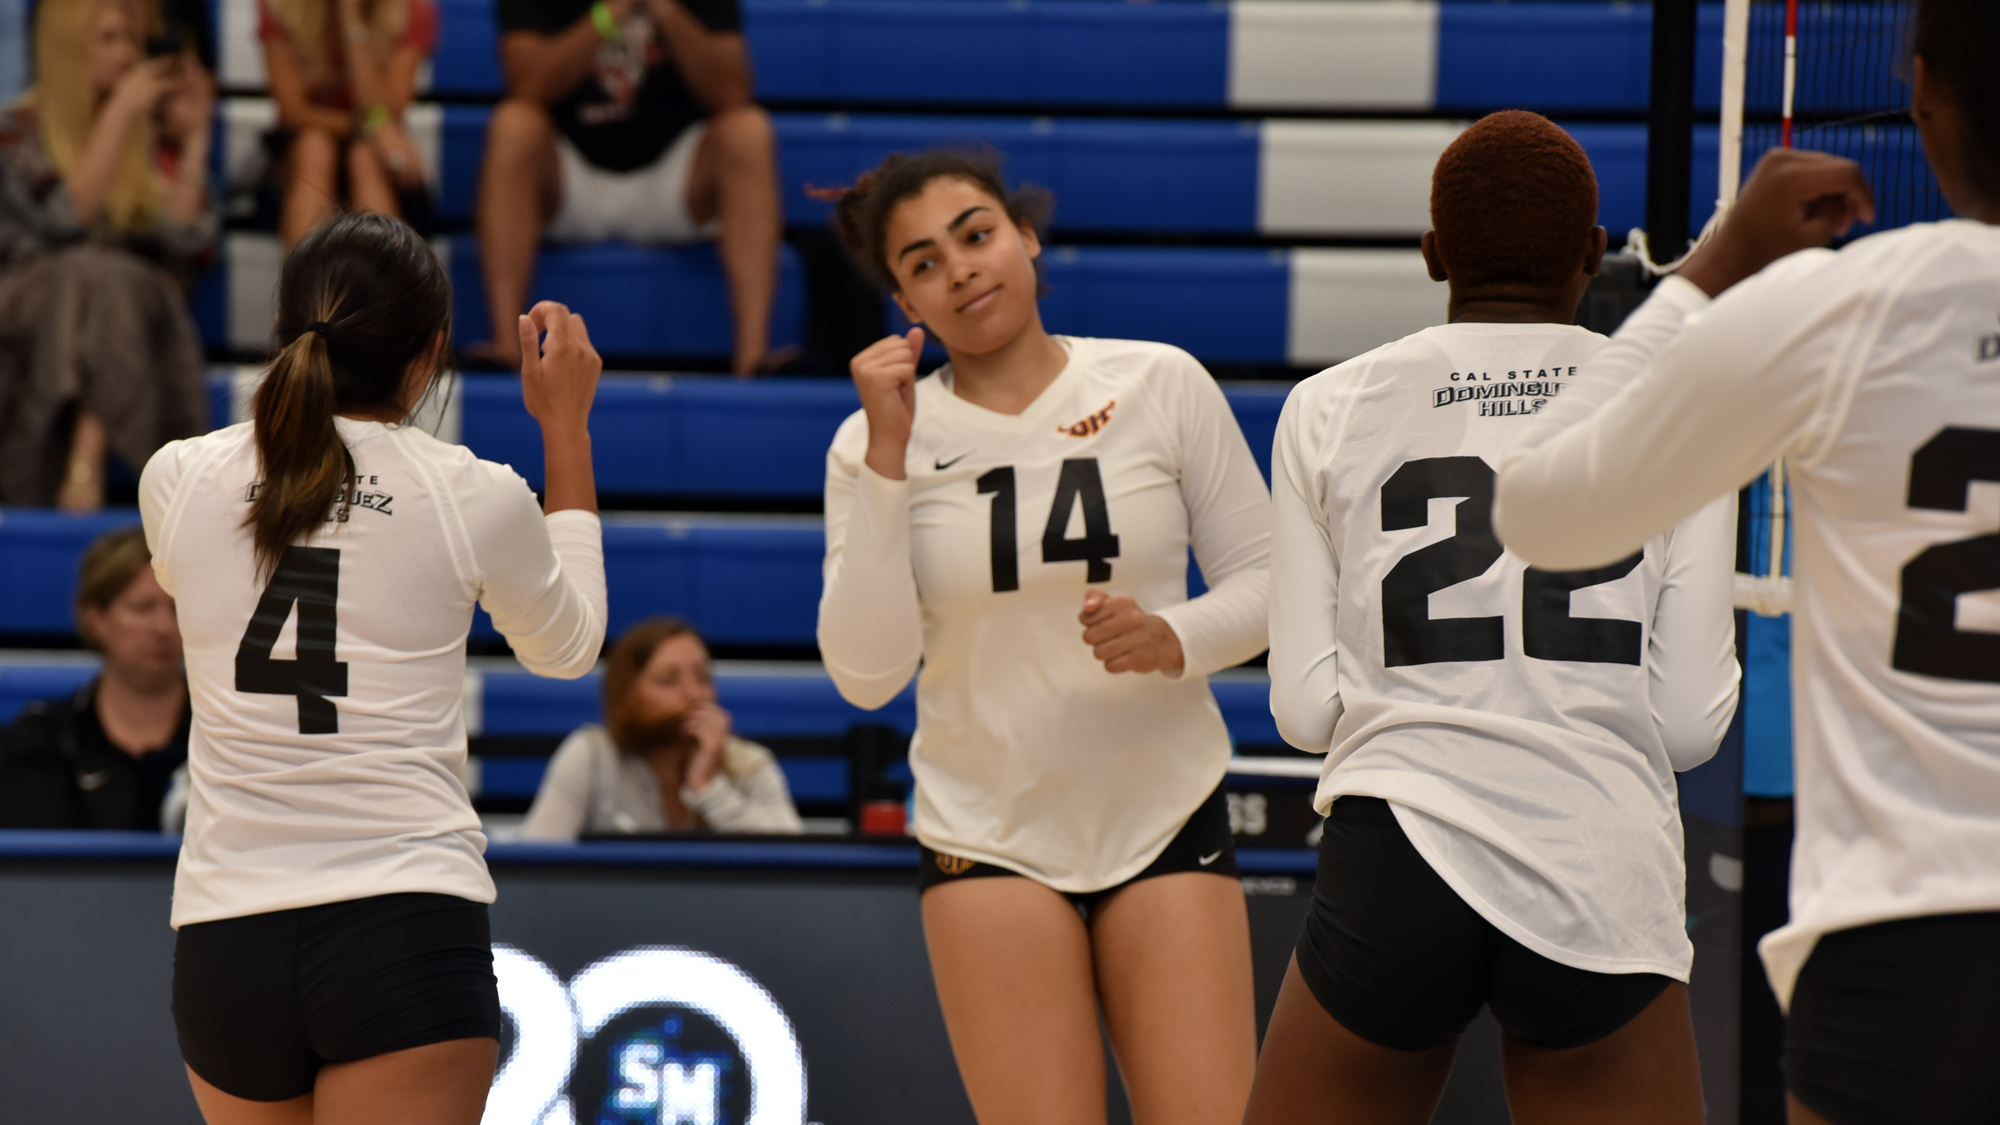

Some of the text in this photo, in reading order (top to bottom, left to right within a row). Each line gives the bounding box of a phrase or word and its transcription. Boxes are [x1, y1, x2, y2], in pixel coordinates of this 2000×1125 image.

[1432, 380, 1568, 408] DOMINGU
[1449, 365, 1578, 382] CAL STATE
[975, 456, 1121, 593] 14
[1380, 455, 1645, 668] 22
[234, 545, 348, 735] 4
